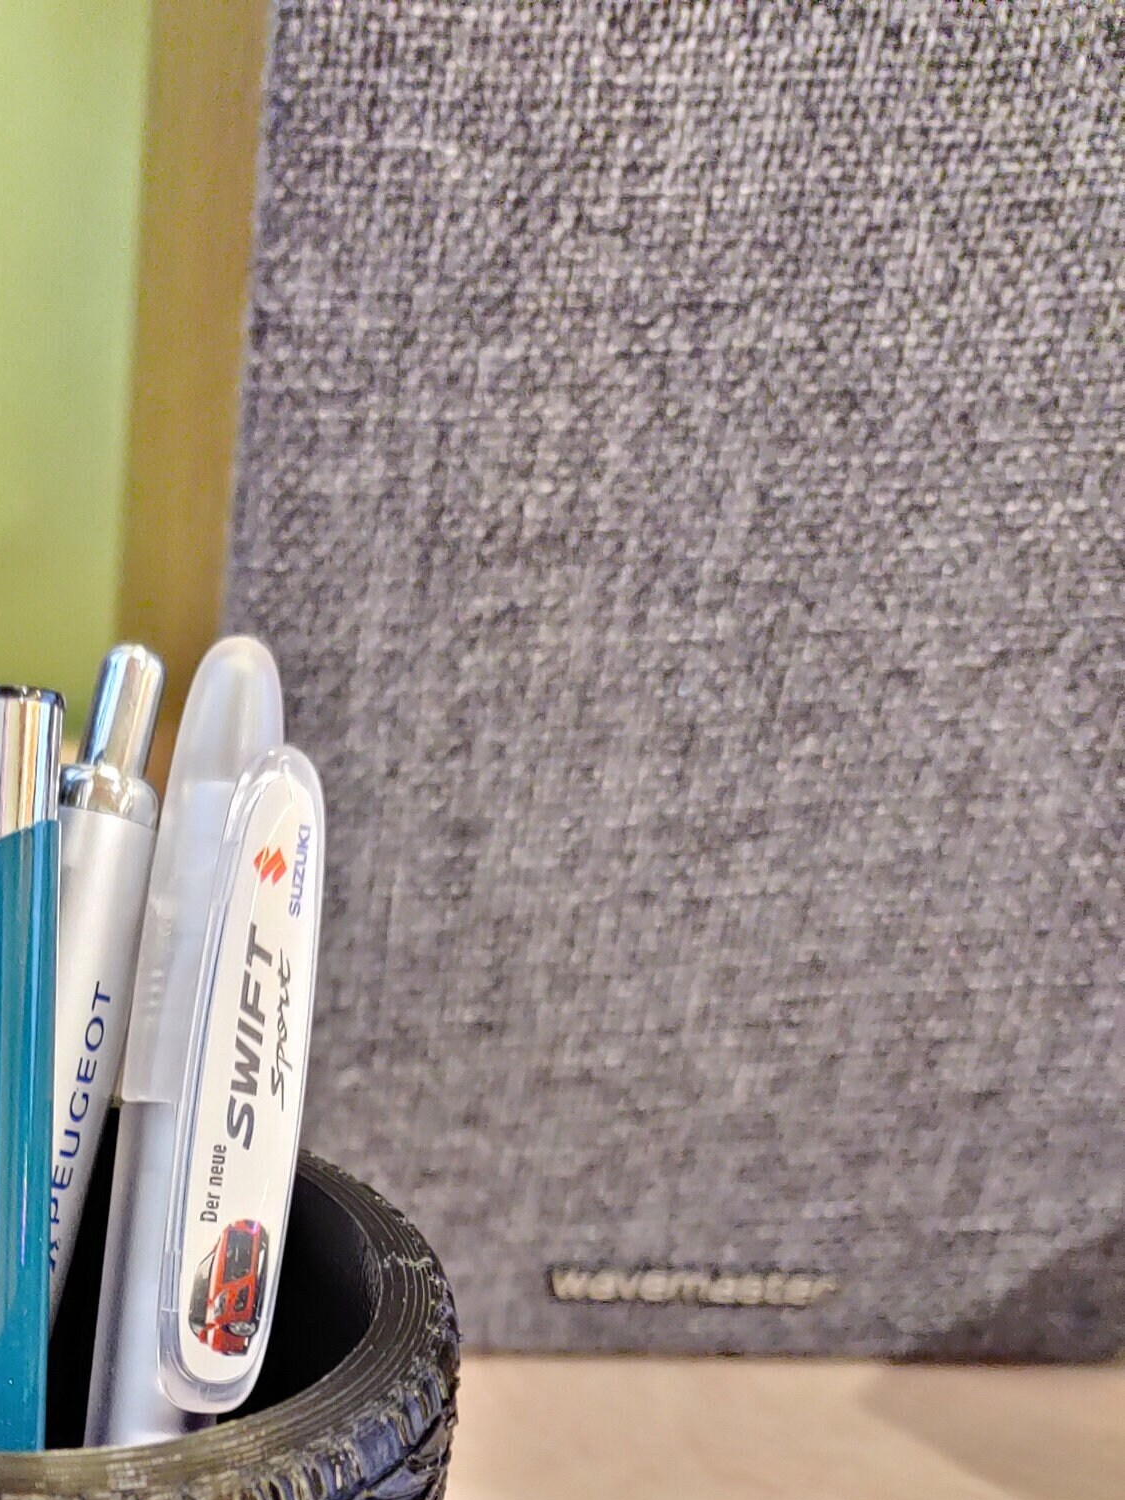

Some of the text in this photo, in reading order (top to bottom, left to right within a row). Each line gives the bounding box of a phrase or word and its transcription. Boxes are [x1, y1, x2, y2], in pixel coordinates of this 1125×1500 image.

[288, 824, 312, 918] SUZUKI
[226, 922, 274, 1151] SWIFT
[199, 1143, 227, 1223] Der neue
